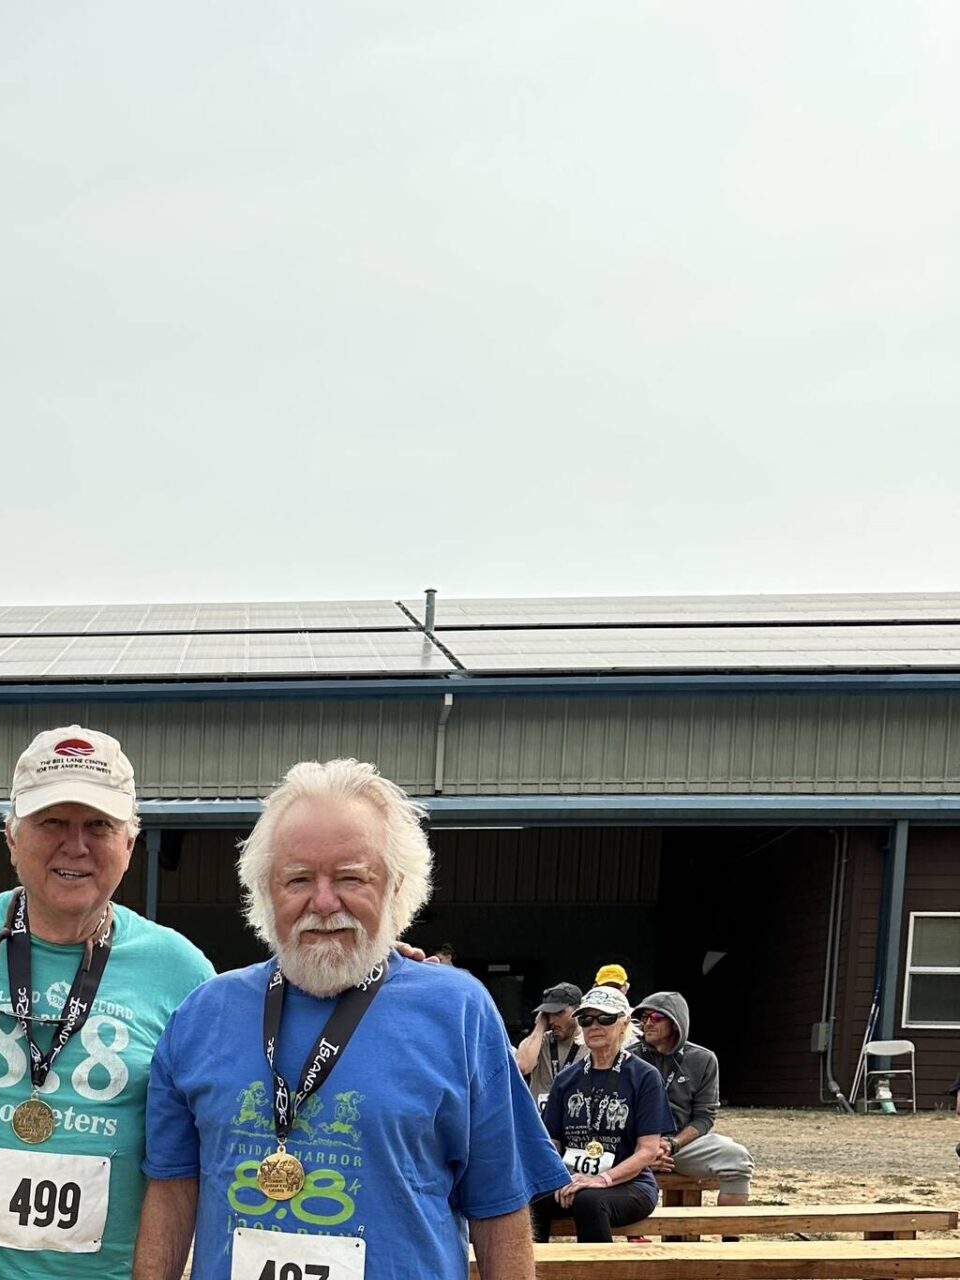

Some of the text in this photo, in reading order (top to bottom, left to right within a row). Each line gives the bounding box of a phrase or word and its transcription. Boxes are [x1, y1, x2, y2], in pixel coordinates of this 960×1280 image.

[85, 758, 108, 767] CENTER
[90, 1000, 134, 1020] ECORD
[229, 1142, 363, 1167] FRIDA HARBOR
[573, 1155, 600, 1176] 163
[9, 1177, 81, 1230] 499
